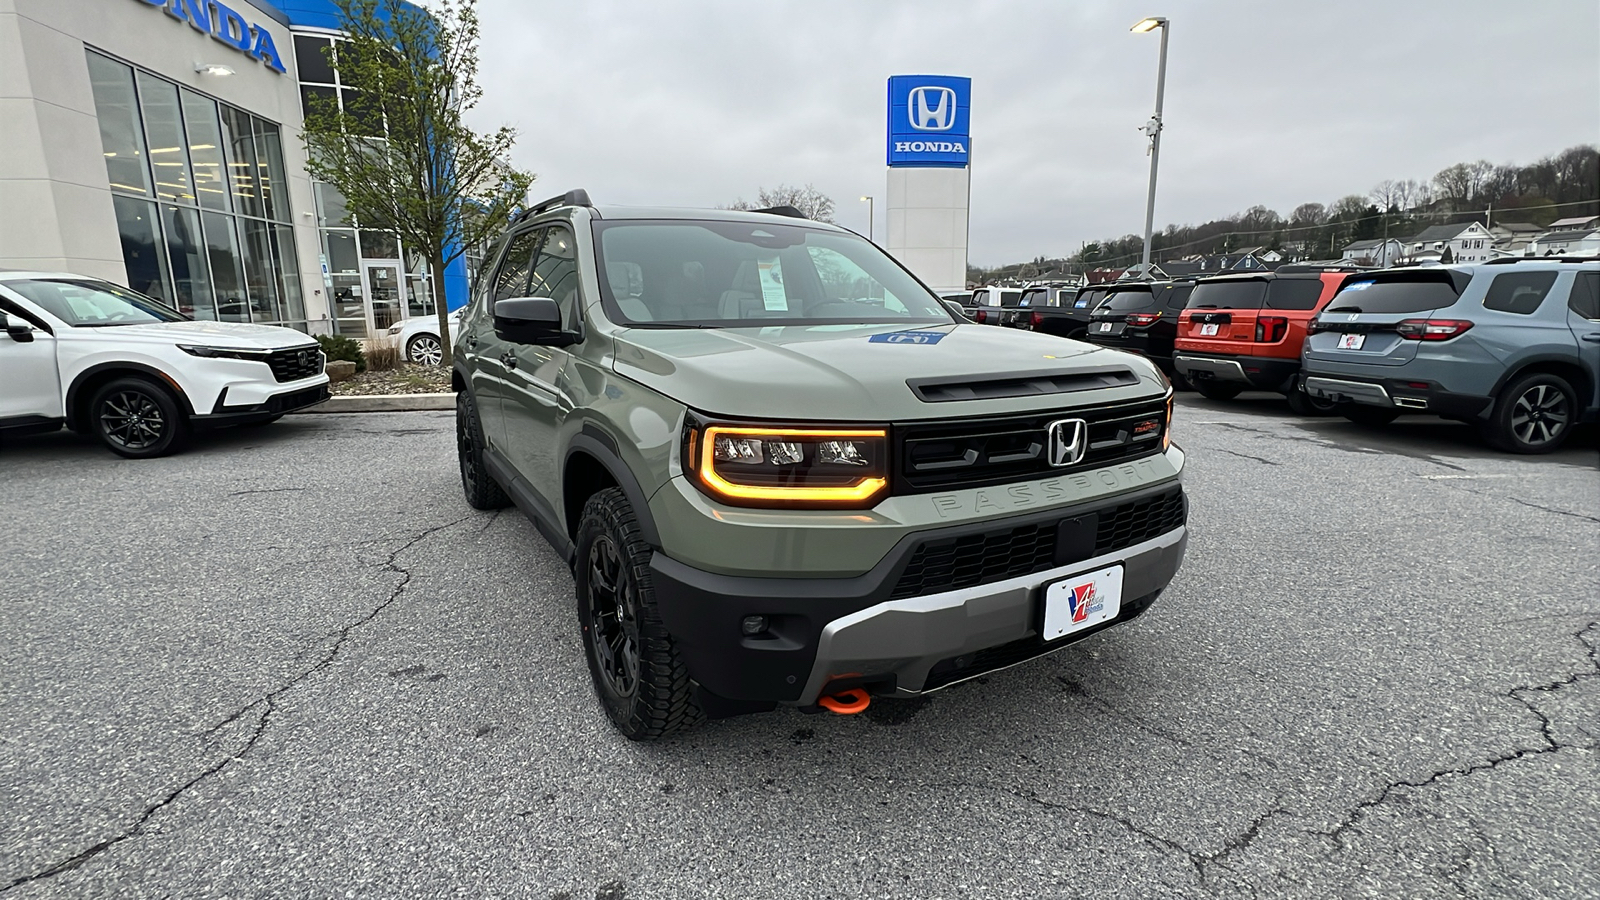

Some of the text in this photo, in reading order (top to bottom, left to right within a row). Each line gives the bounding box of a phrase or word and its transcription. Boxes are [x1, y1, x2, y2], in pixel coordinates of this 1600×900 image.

[140, 0, 287, 74] NDA
[894, 141, 967, 153] HONDA
[931, 459, 1158, 518] PASSPORT
